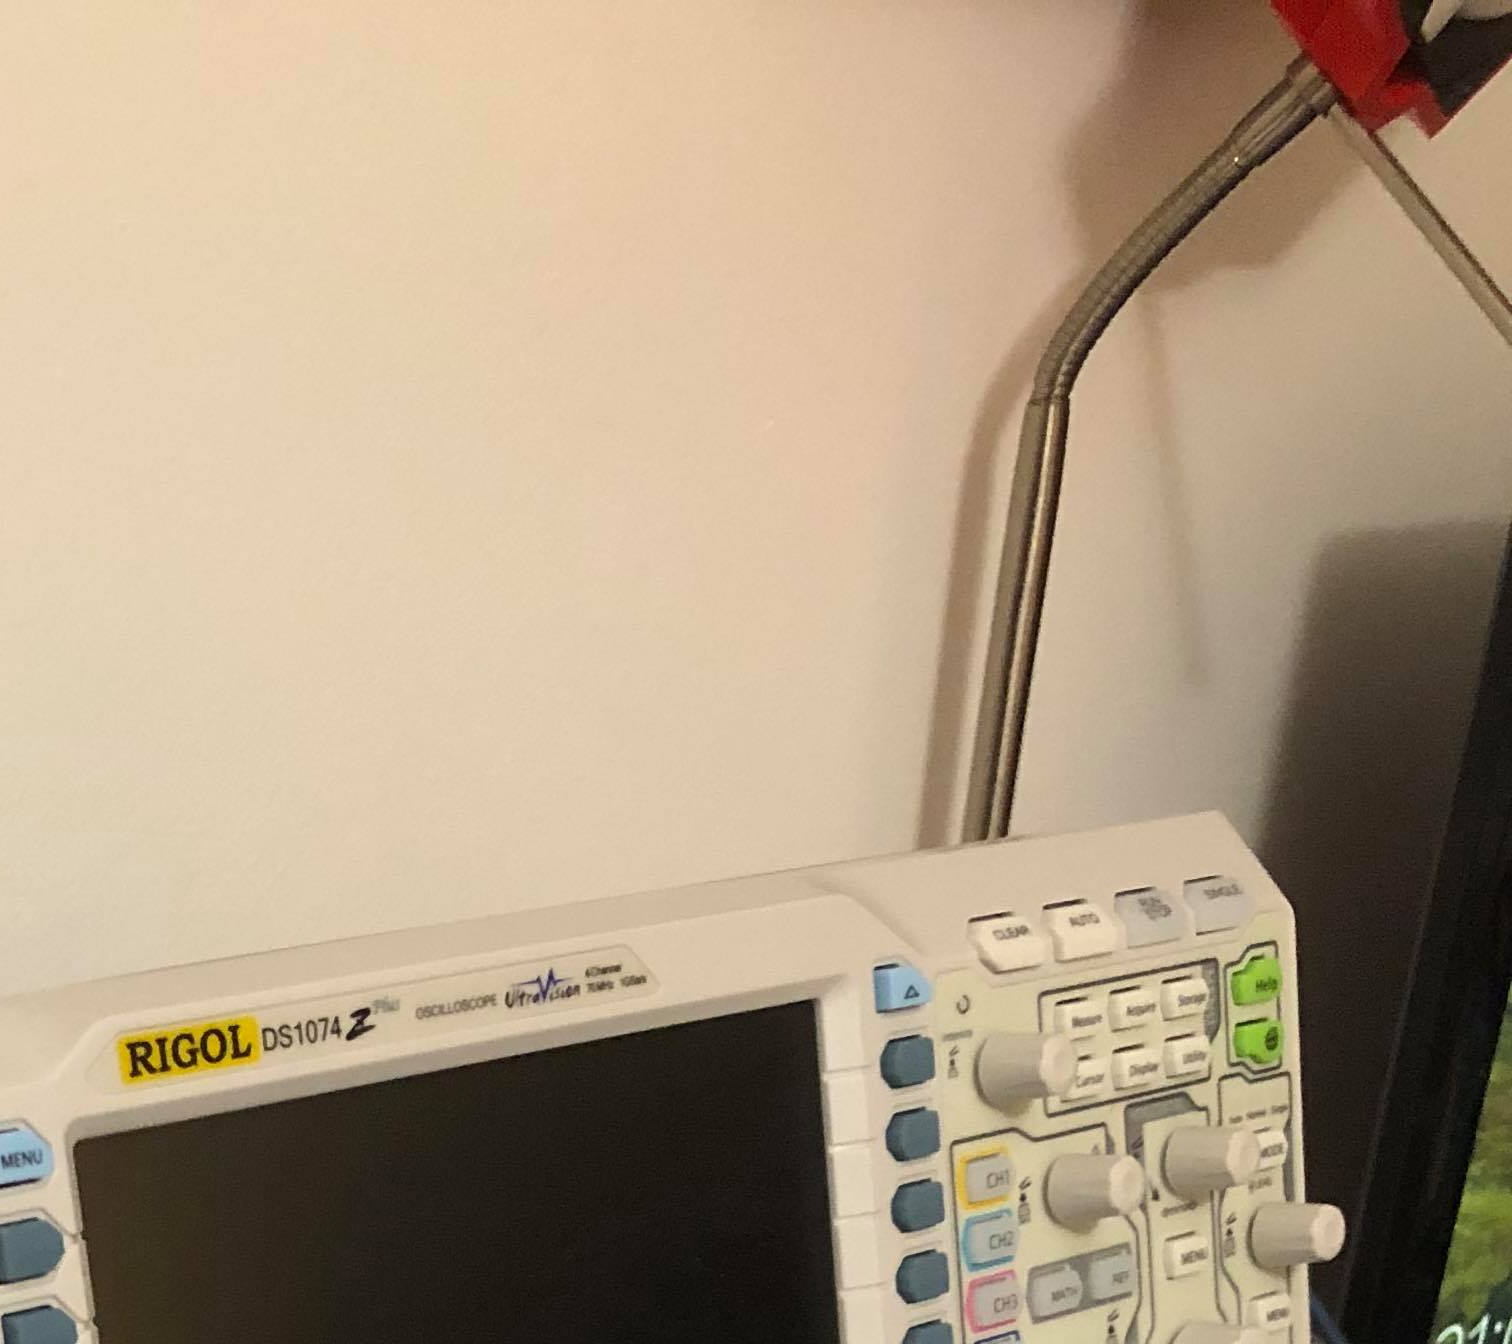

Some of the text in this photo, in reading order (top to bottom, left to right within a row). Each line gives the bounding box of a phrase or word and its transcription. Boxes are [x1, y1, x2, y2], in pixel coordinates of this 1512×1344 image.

[1068, 911, 1101, 927] AUTO
[125, 1024, 252, 1079] RIGOL
[414, 992, 499, 1021] OSCILLOSCOPE
[0, 1148, 44, 1170] MENU
[986, 1169, 1011, 1189] CH1
[989, 1231, 1014, 1251] CH2
[993, 1294, 1019, 1314] CH3
